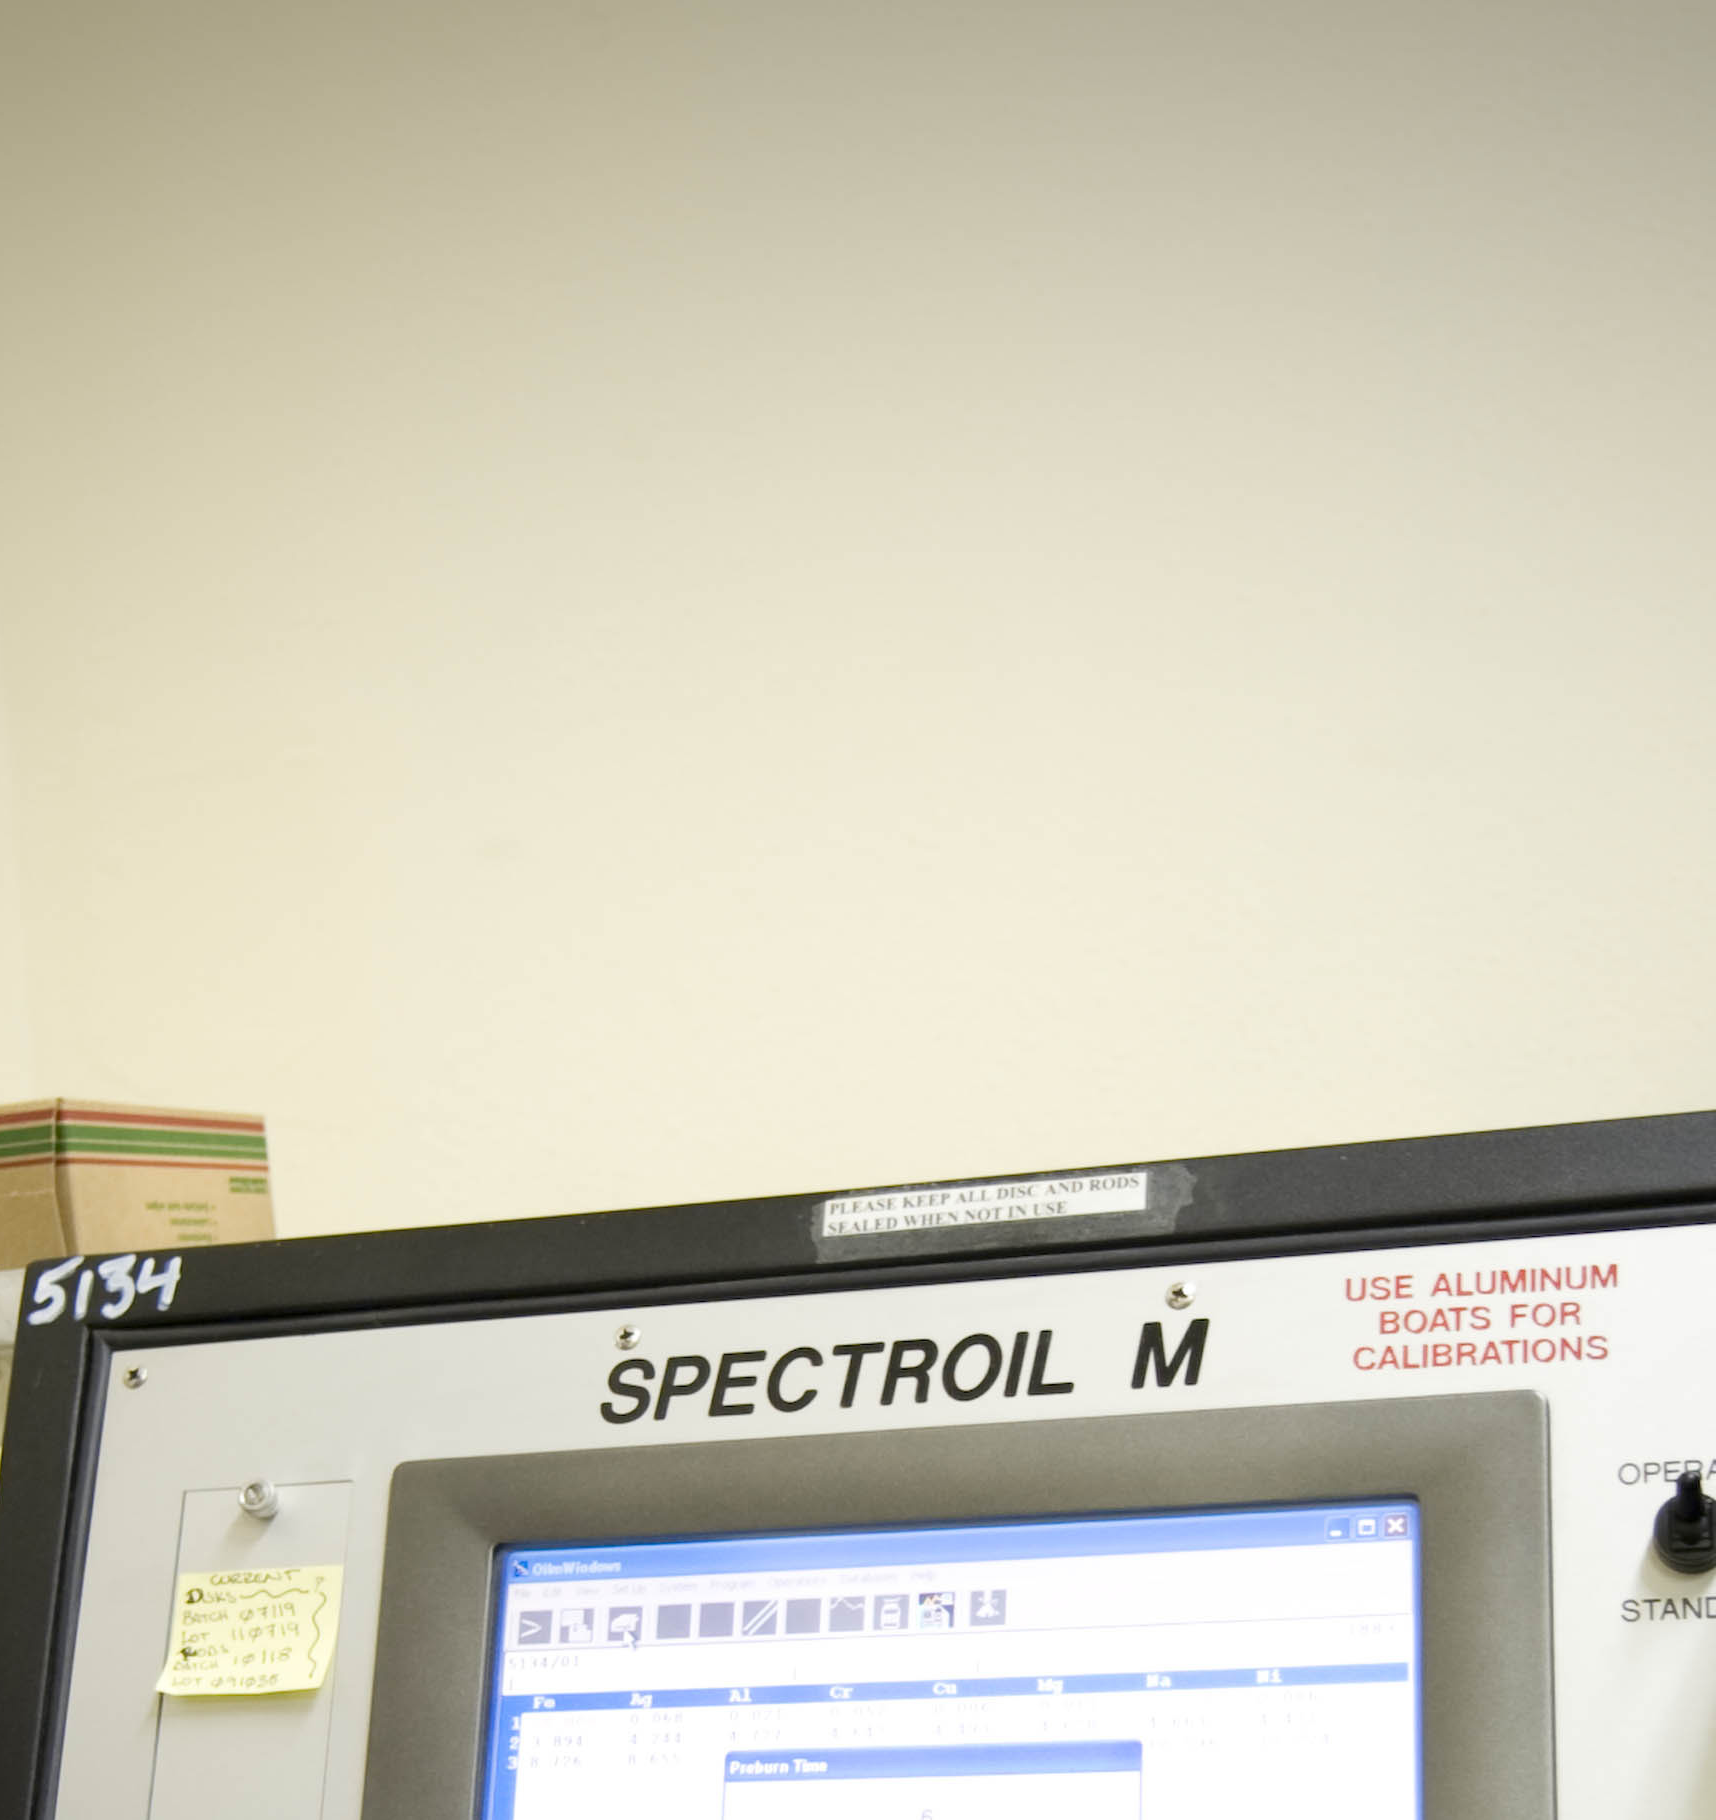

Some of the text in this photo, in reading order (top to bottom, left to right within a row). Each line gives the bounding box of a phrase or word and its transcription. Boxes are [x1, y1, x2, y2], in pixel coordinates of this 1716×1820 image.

[829, 1175, 1140, 1215] PLEASE KEEP ALL DISC AND RODS
[827, 1201, 1068, 1235] SEALED WHEN NOT IN USE
[27, 1254, 182, 1325] 5134
[1345, 1264, 1618, 1302] USE ALUMINUM
[1379, 1302, 1582, 1334] BOATS FOR
[1353, 1336, 1609, 1370] CALIBRATIONS
[601, 1319, 1209, 1424] SPECTROIL M
[533, 1696, 556, 1709] Fe
[630, 1693, 653, 1708] Ag
[729, 1688, 752, 1703] Al
[829, 1686, 854, 1699] Cr
[932, 1682, 958, 1695] Cu
[510, 1736, 520, 1749] 2
[508, 1756, 517, 1770] 3
[730, 1757, 828, 1776] Preburn Time
